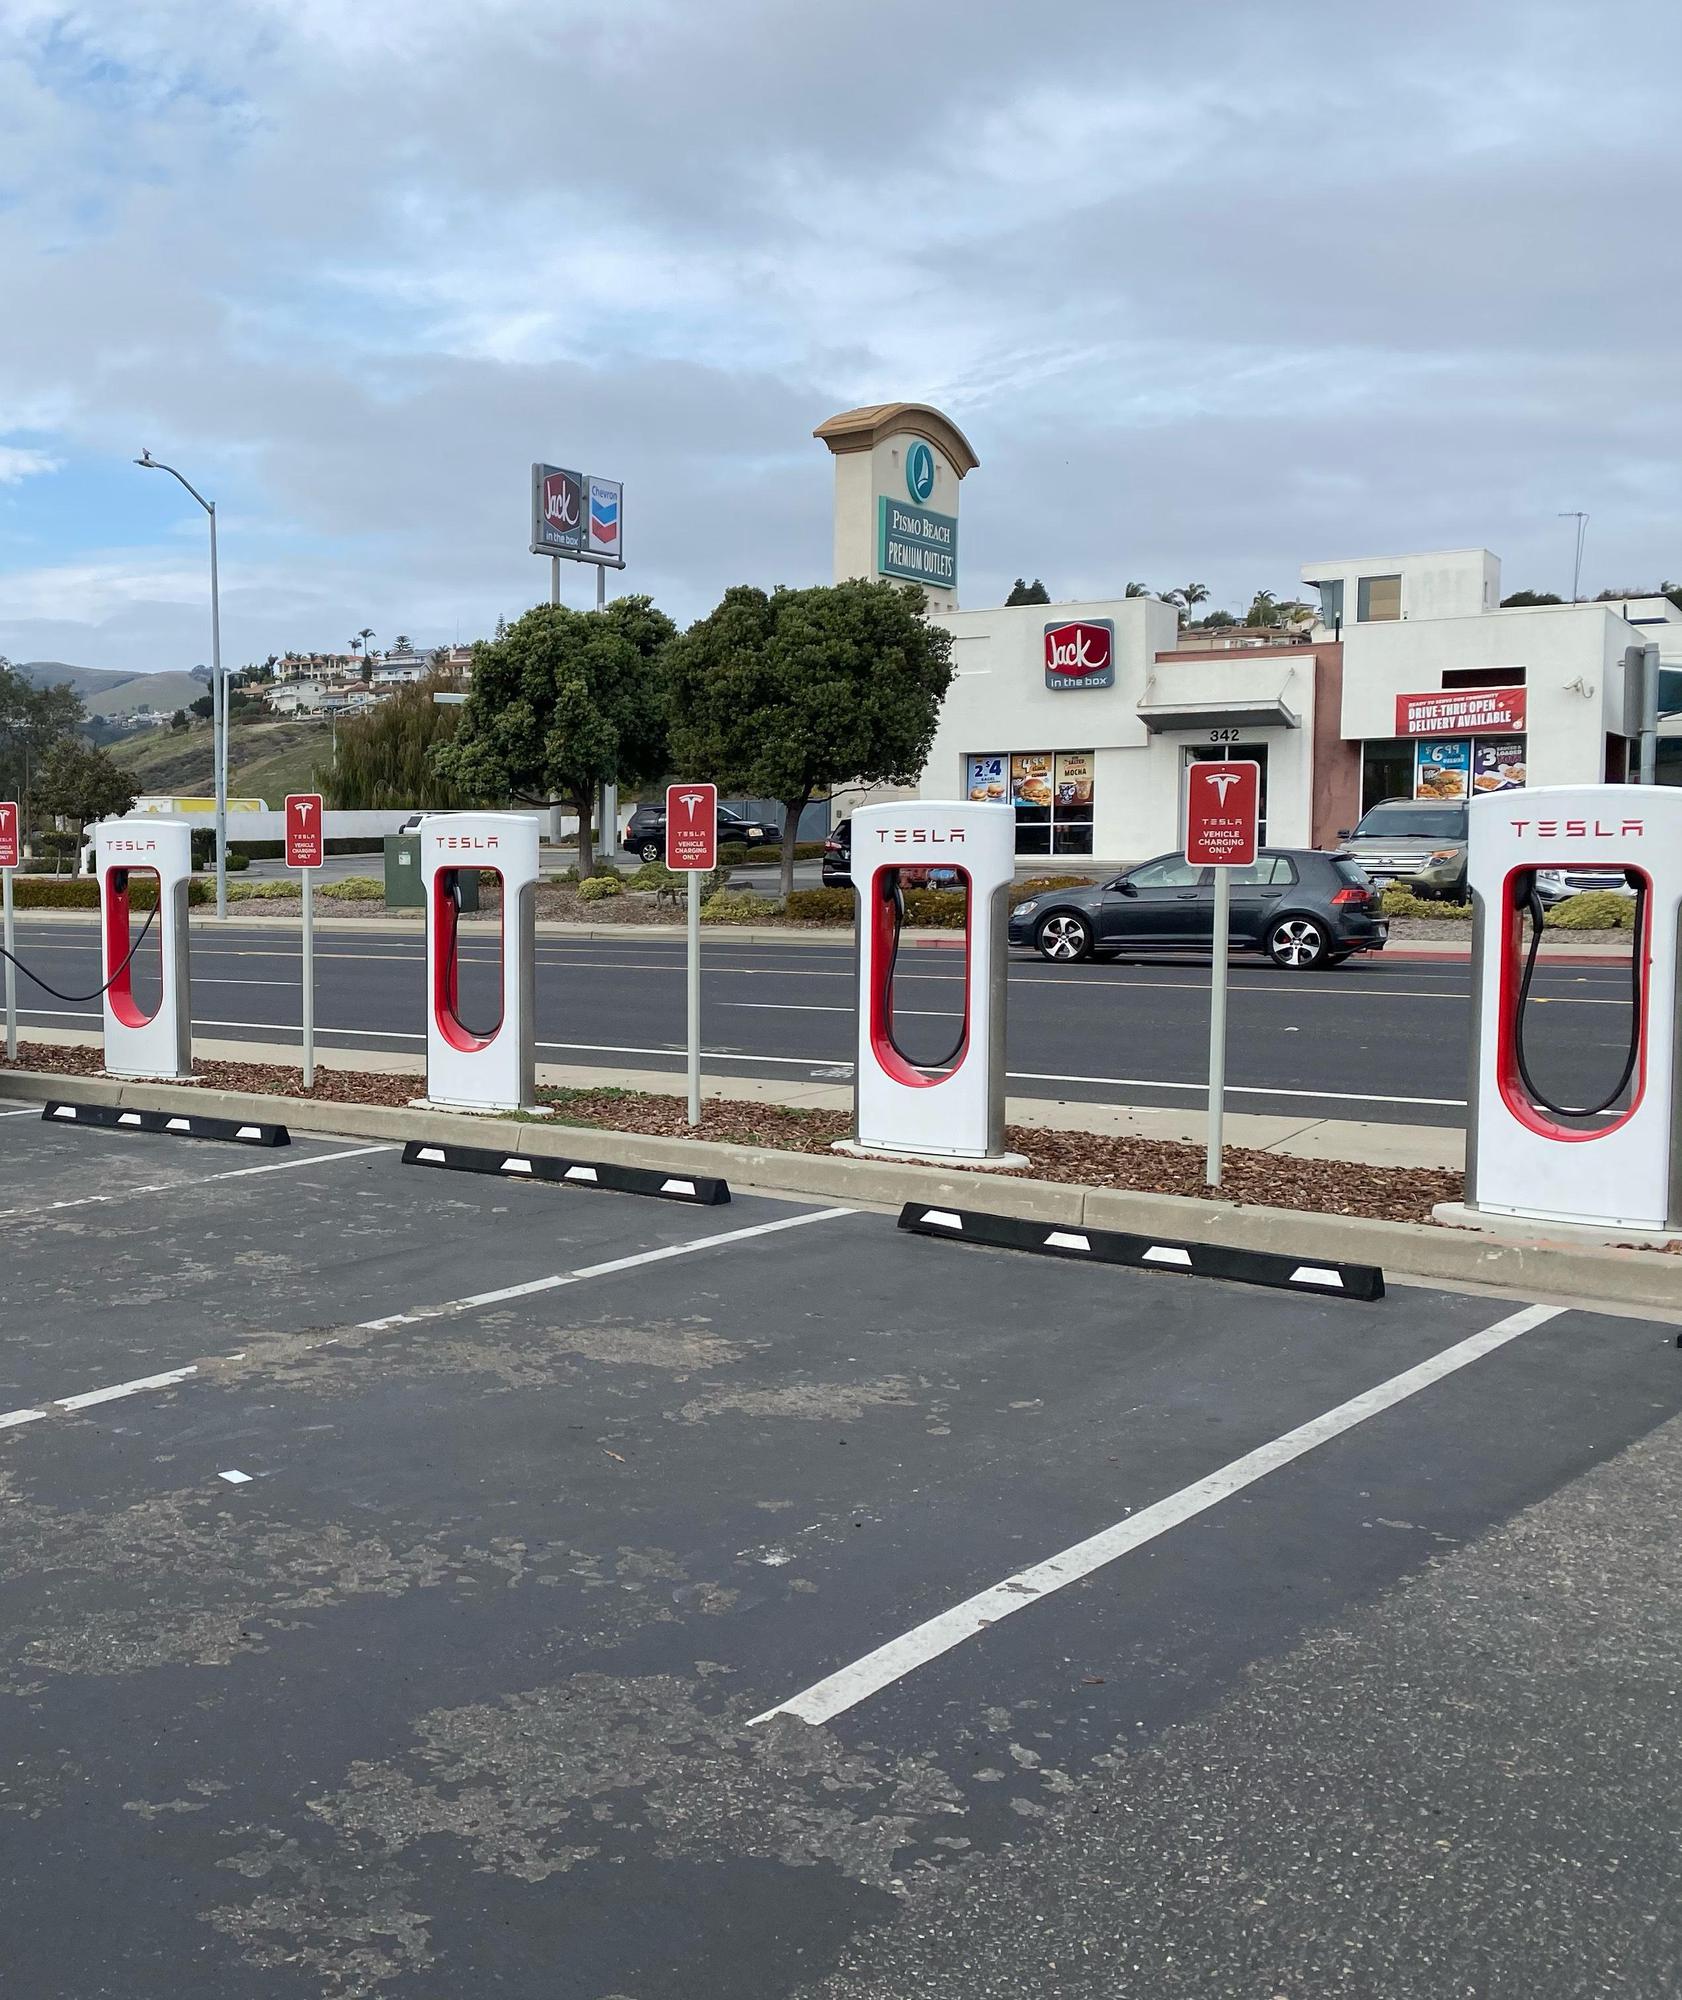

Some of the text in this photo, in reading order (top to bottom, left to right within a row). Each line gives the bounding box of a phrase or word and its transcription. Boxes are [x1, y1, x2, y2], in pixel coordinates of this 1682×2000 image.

[592, 485, 618, 501] Chevron
[545, 480, 579, 525] Jack
[893, 510, 950, 543] PISMO BEACH
[546, 530, 578, 546] in the box
[889, 541, 953, 577] PREMIUM OUTLETS
[1047, 629, 1108, 669] Jack
[1051, 677, 1107, 687] in the box
[1408, 702, 1467, 720] DRIVE-THRU
[1469, 699, 1496, 713] OPEN
[1408, 710, 1512, 733] DELIVERY AVAILABLE
[1210, 729, 1240, 742] 342
[1064, 768, 1087, 776] MOCHA
[875, 829, 965, 843] TESLA
[1510, 819, 1644, 838] TESLA
[106, 840, 155, 851] TESLA
[436, 837, 498, 849] TESLA
[1198, 838, 1244, 846] CHARGING
[1209, 846, 1233, 854] ONLY
